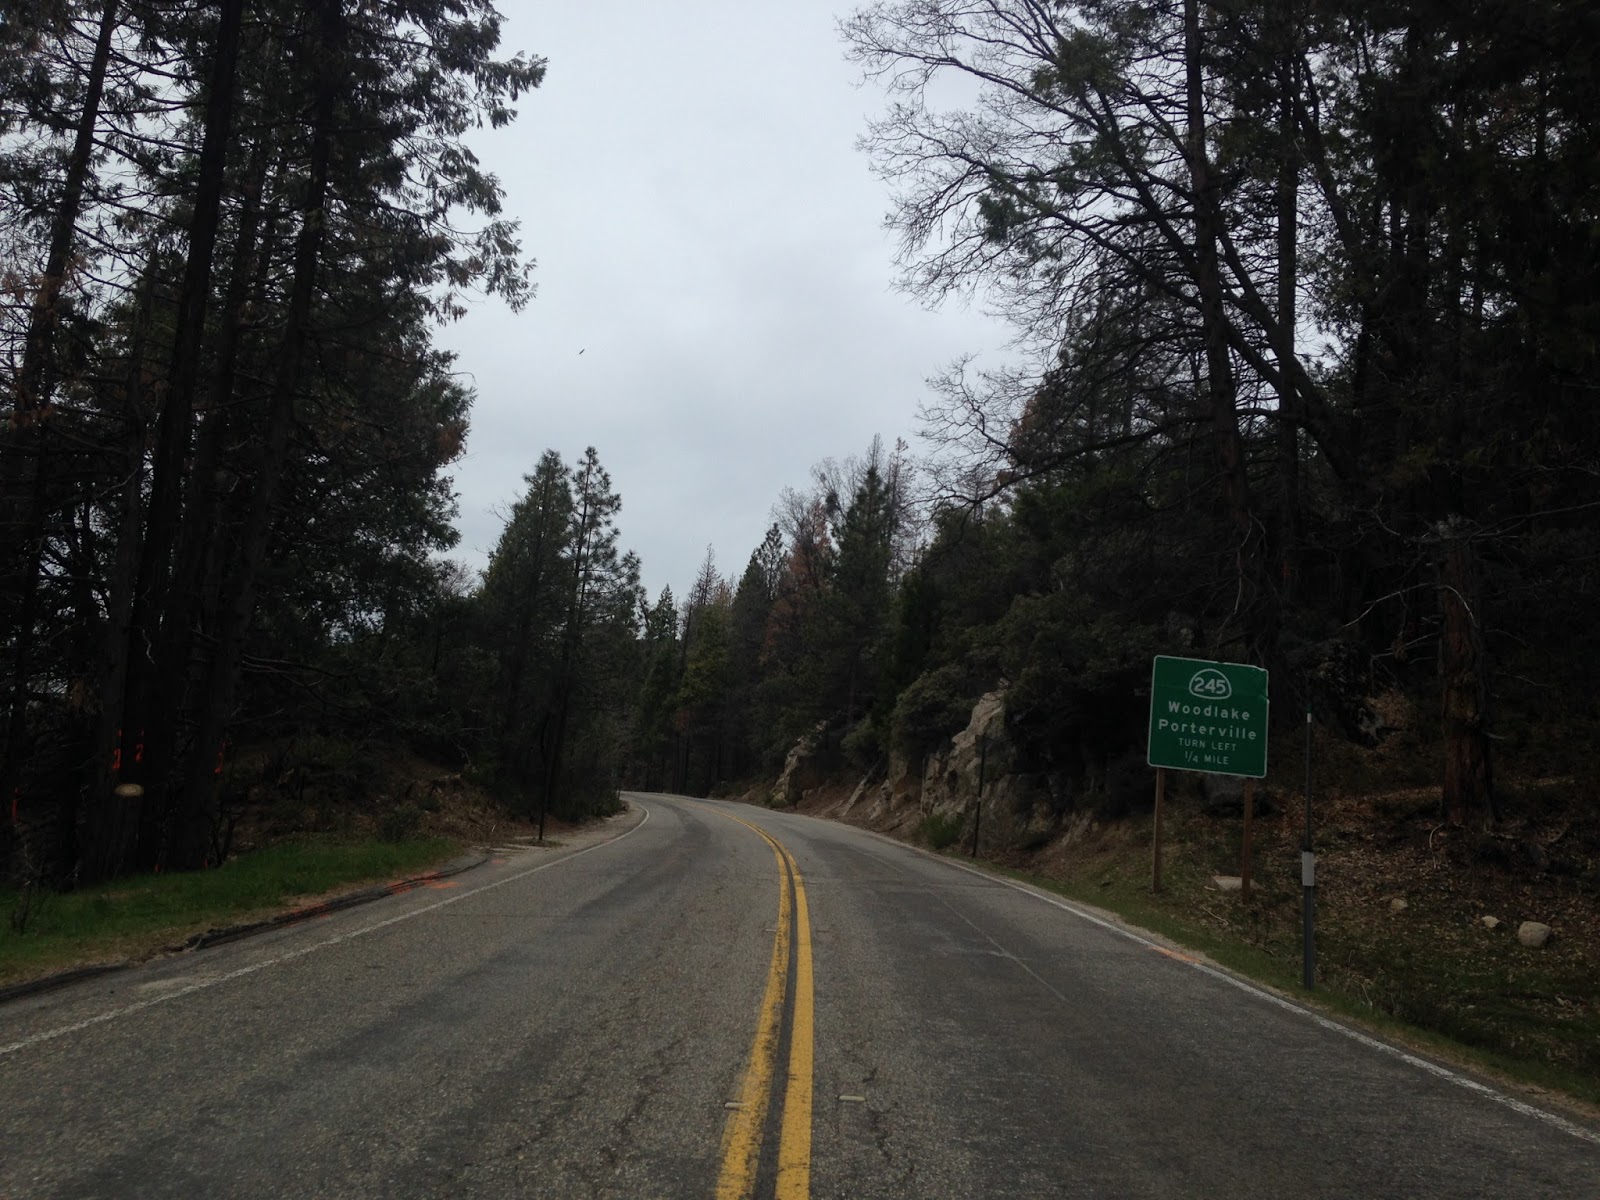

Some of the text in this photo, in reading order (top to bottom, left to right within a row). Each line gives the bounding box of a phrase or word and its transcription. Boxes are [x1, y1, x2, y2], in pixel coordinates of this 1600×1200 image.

[1193, 676, 1226, 695] 245
[1168, 700, 1250, 720] Woodlake
[1158, 719, 1257, 740] Porterville
[1179, 737, 1237, 752] TURN LEFT
[1203, 754, 1229, 765] MILE
